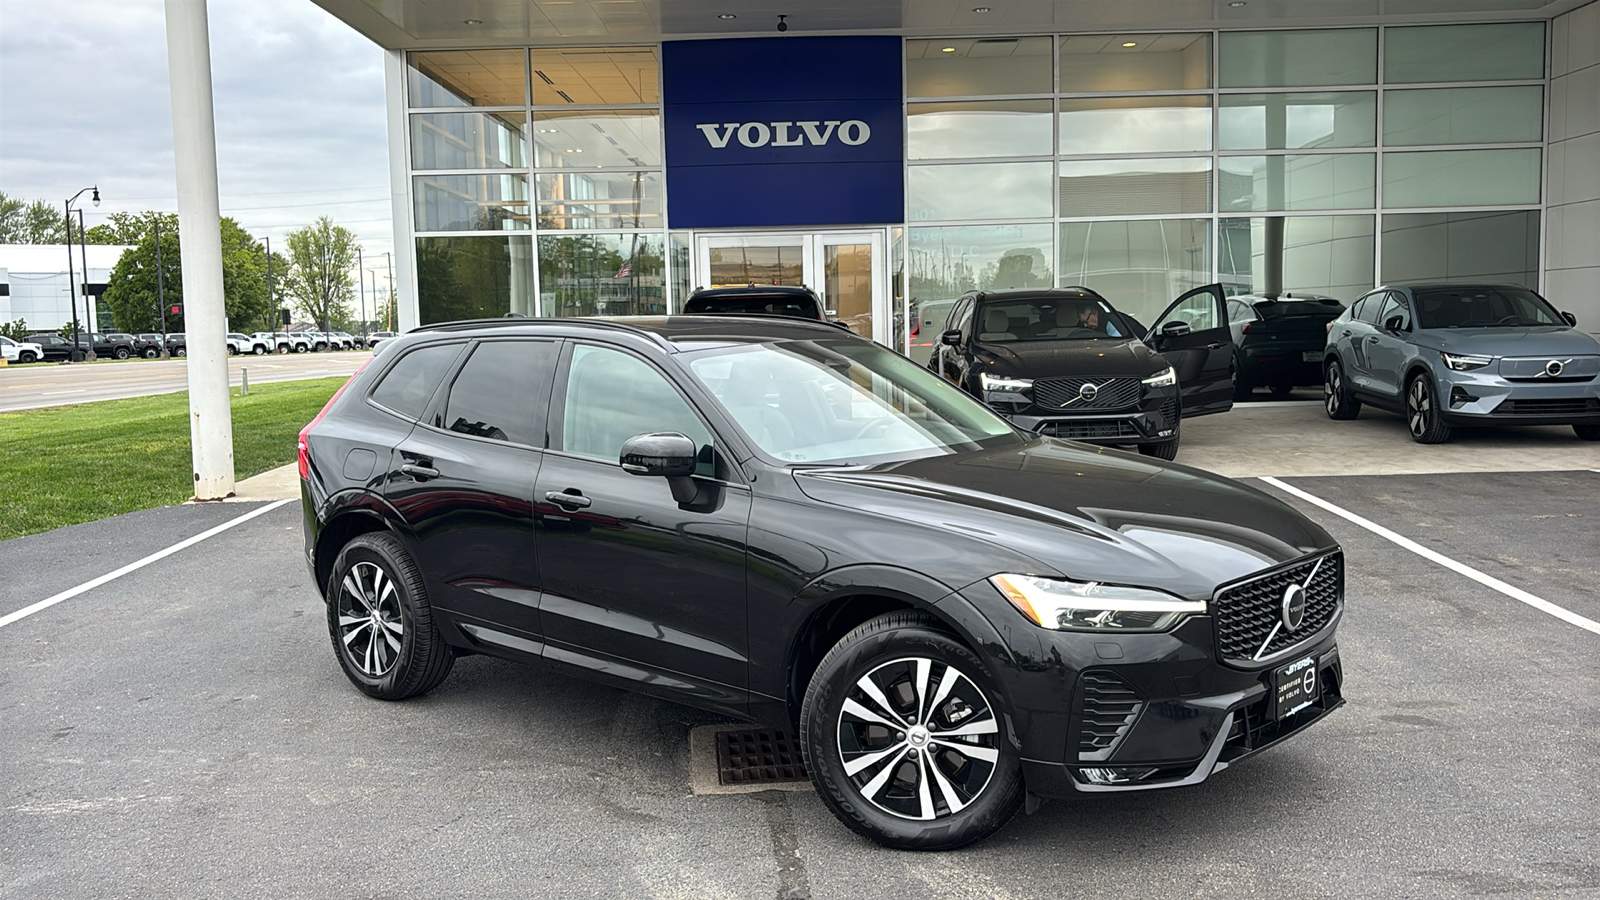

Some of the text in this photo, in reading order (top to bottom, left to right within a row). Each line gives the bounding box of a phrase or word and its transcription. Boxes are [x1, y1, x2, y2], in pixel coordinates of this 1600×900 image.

[696, 119, 871, 148] VOLVO
[951, 245, 979, 258] LLC
[1286, 657, 1314, 675] BYERS
[1286, 688, 1300, 699] VOLVO
[814, 684, 833, 738] ZERO
[814, 744, 874, 830] SCORPION
